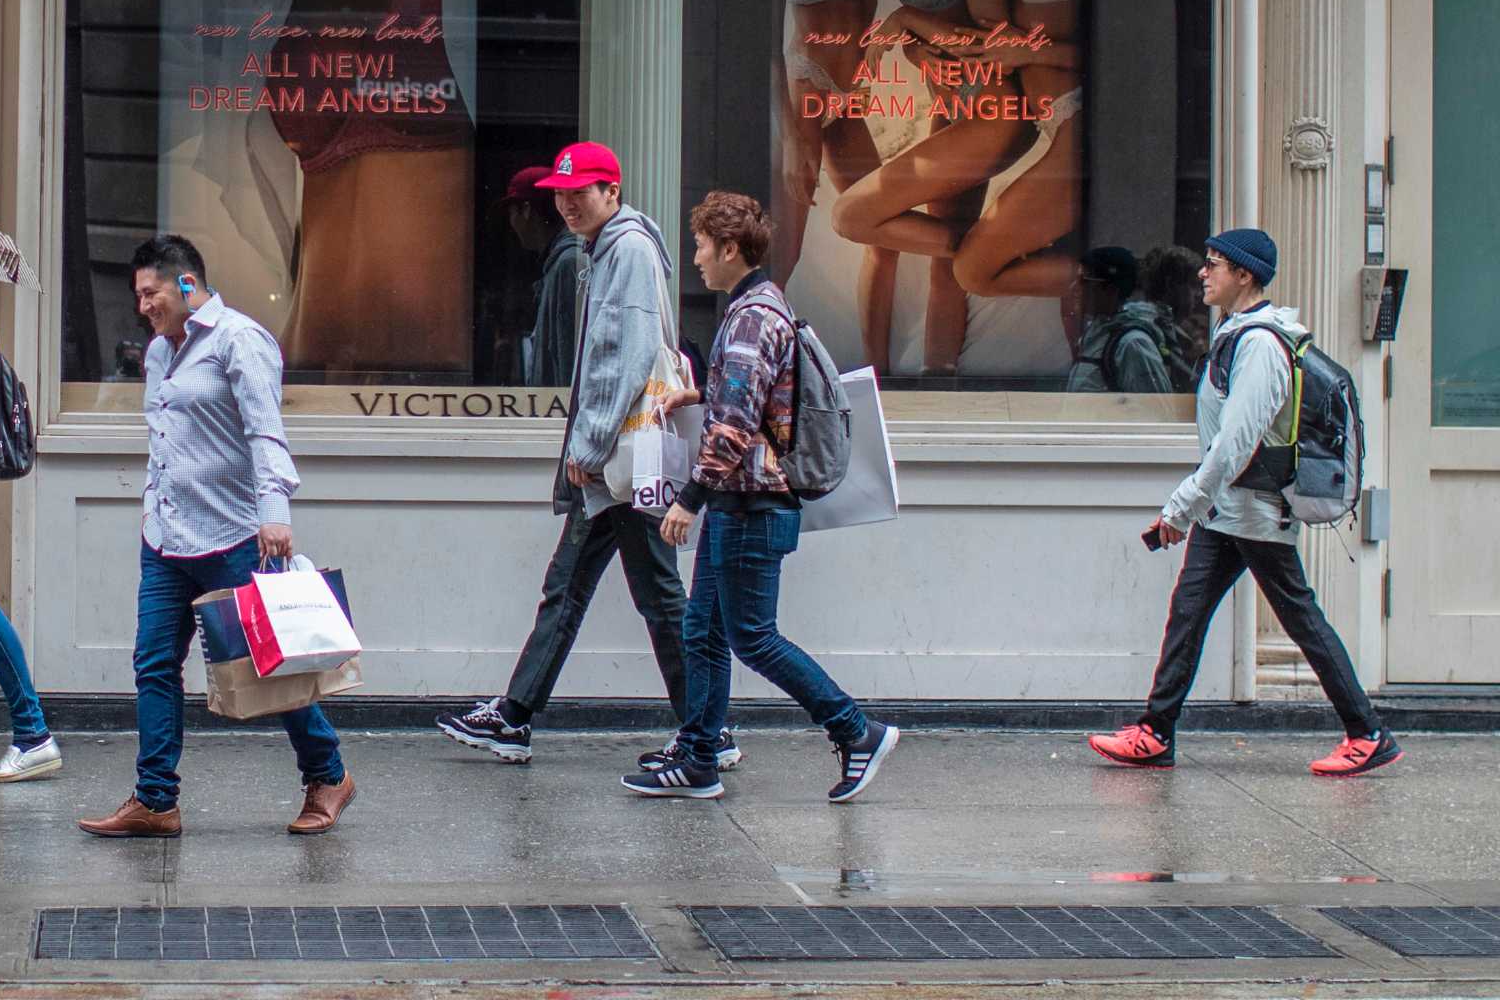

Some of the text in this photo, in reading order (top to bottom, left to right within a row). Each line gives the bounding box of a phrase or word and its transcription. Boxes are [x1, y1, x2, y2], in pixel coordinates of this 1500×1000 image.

[194, 23, 241, 38] new
[319, 25, 368, 39] new
[803, 30, 851, 45] new
[929, 31, 977, 46] new
[240, 53, 395, 79] ALL NEW!
[851, 60, 1004, 86] ALL NEW!
[188, 87, 447, 114] DREAM ANGELS
[802, 92, 1055, 120] DREAM ANGELS
[350, 392, 569, 418] VICTORIA
